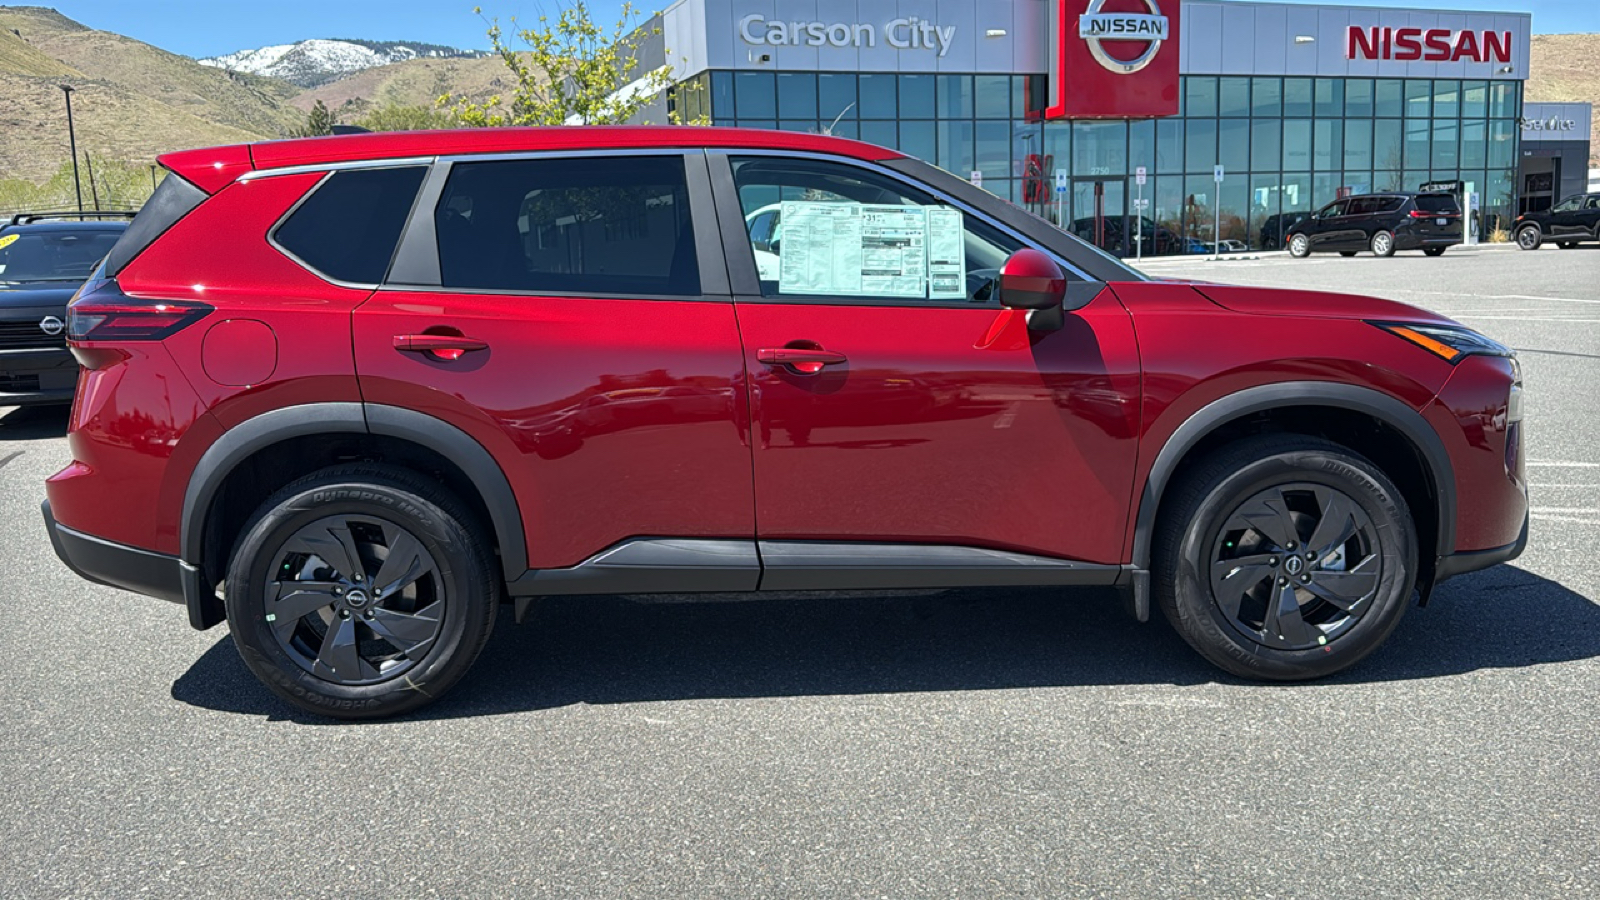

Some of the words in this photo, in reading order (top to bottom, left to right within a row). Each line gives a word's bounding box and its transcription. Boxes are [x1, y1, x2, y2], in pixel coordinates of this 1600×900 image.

[739, 13, 876, 47] Carson
[885, 16, 957, 58] City
[1091, 18, 1162, 36] NISSAN
[1346, 26, 1512, 63] NISSAN
[1524, 114, 1576, 131] Service
[1090, 166, 1110, 175] 2750
